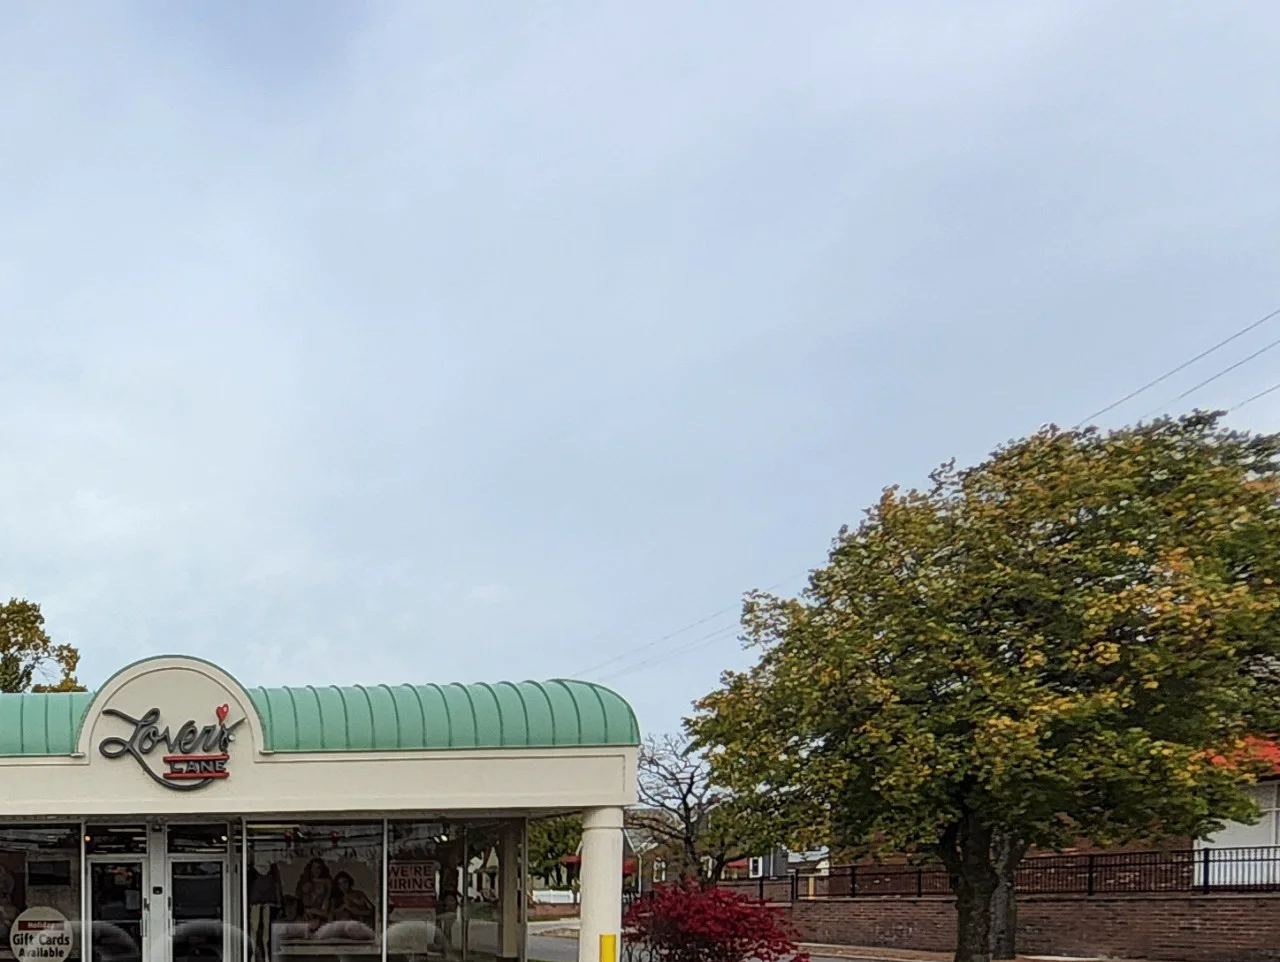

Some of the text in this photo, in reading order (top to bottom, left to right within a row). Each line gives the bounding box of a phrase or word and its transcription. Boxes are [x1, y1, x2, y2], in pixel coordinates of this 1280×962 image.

[170, 760, 227, 774] LANE
[13, 933, 70, 945] Gift Cards
[19, 947, 64, 957] Available
